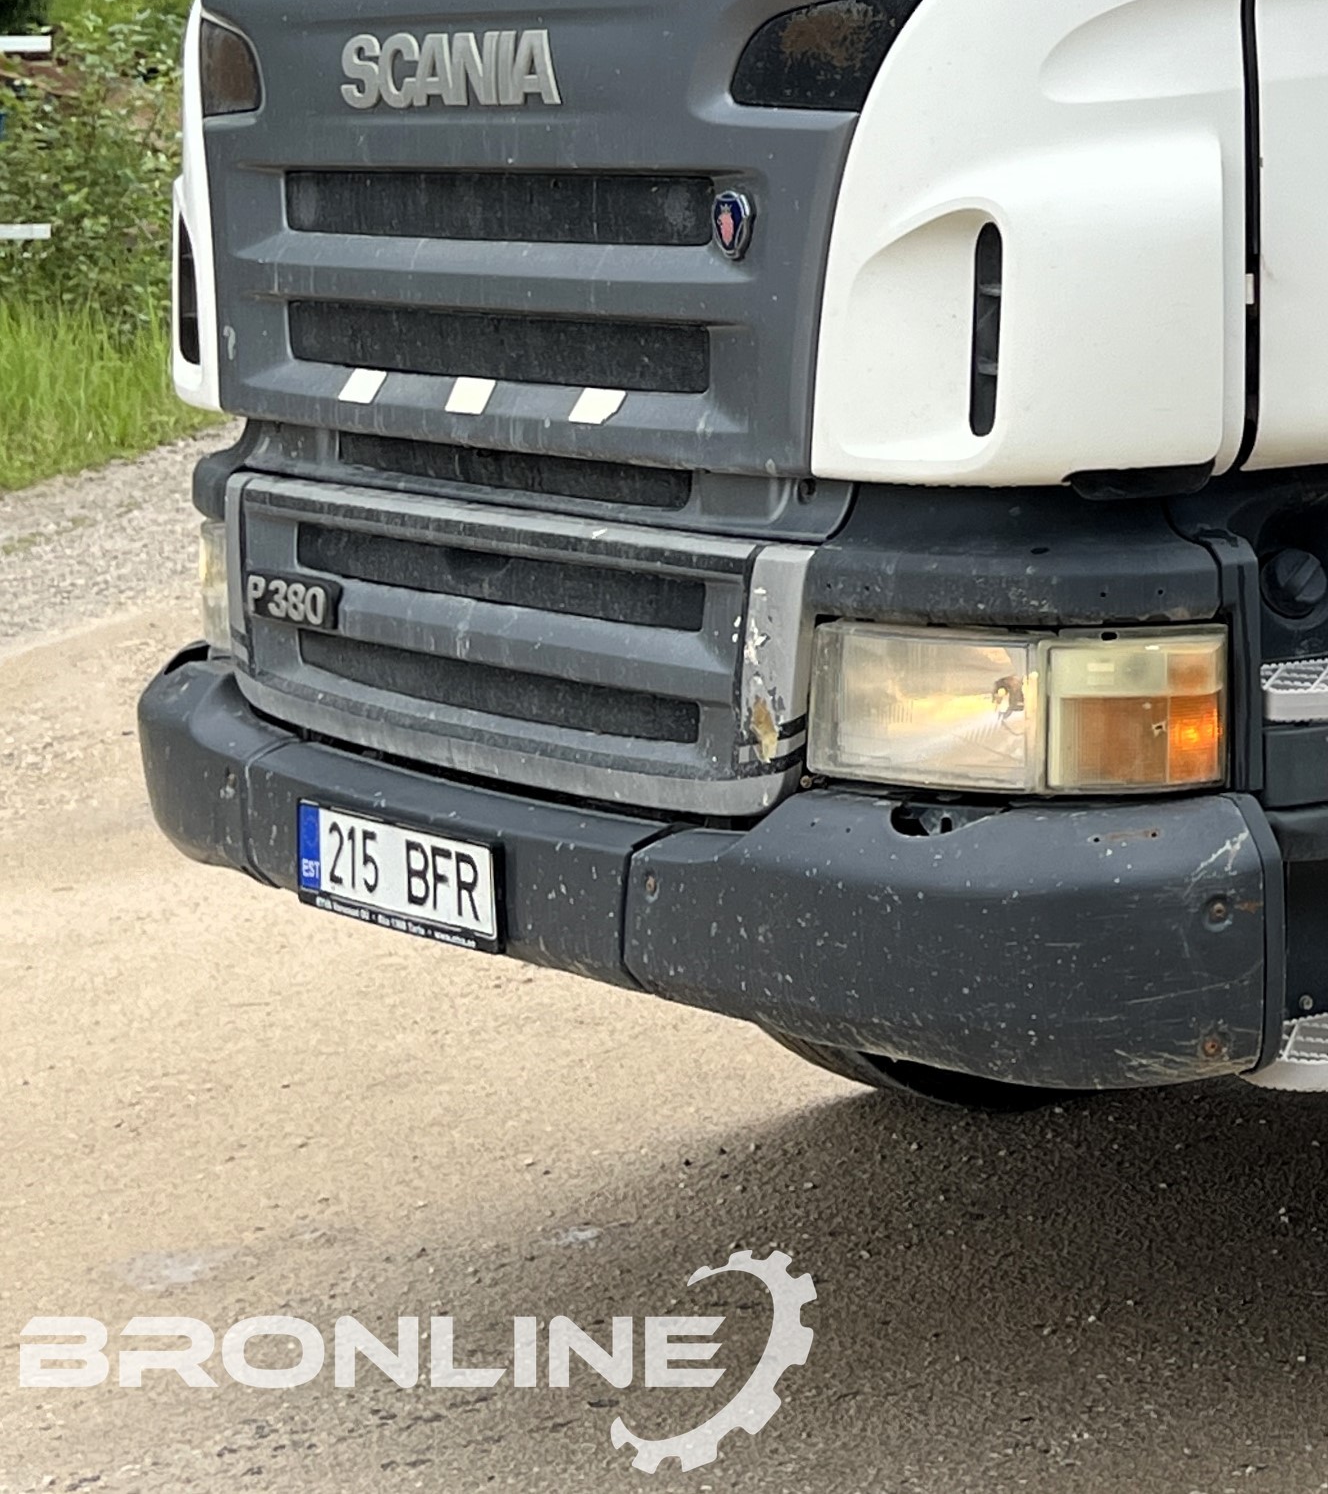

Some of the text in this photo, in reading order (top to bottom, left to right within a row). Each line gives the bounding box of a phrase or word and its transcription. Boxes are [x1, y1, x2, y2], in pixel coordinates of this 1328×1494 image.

[340, 29, 562, 109] SCANIA
[246, 574, 326, 625] P 380
[302, 858, 320, 879] EST
[328, 821, 380, 894] 215
[405, 838, 481, 923] BFR
